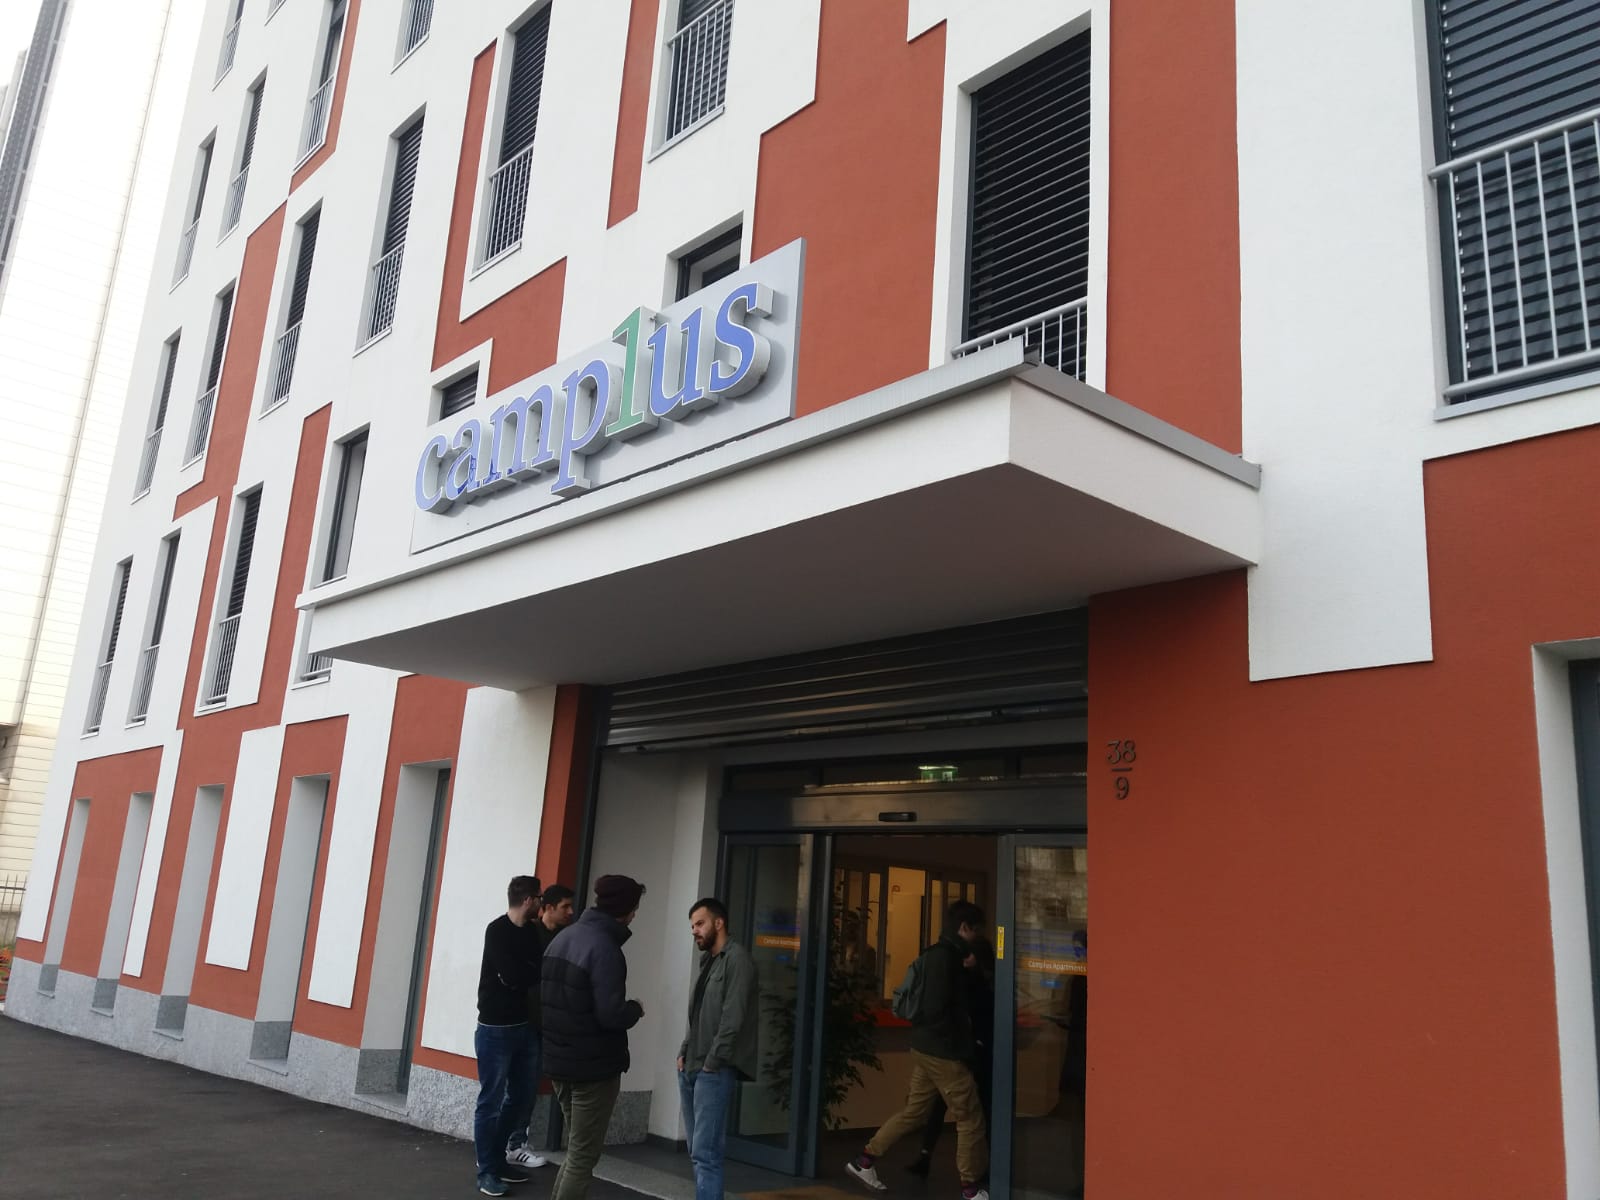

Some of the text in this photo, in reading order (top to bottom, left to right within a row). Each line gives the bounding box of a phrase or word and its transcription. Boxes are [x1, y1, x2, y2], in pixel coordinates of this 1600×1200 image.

[414, 281, 773, 513] camplus
[1106, 739, 1136, 764] 38
[1115, 776, 1130, 800] 9
